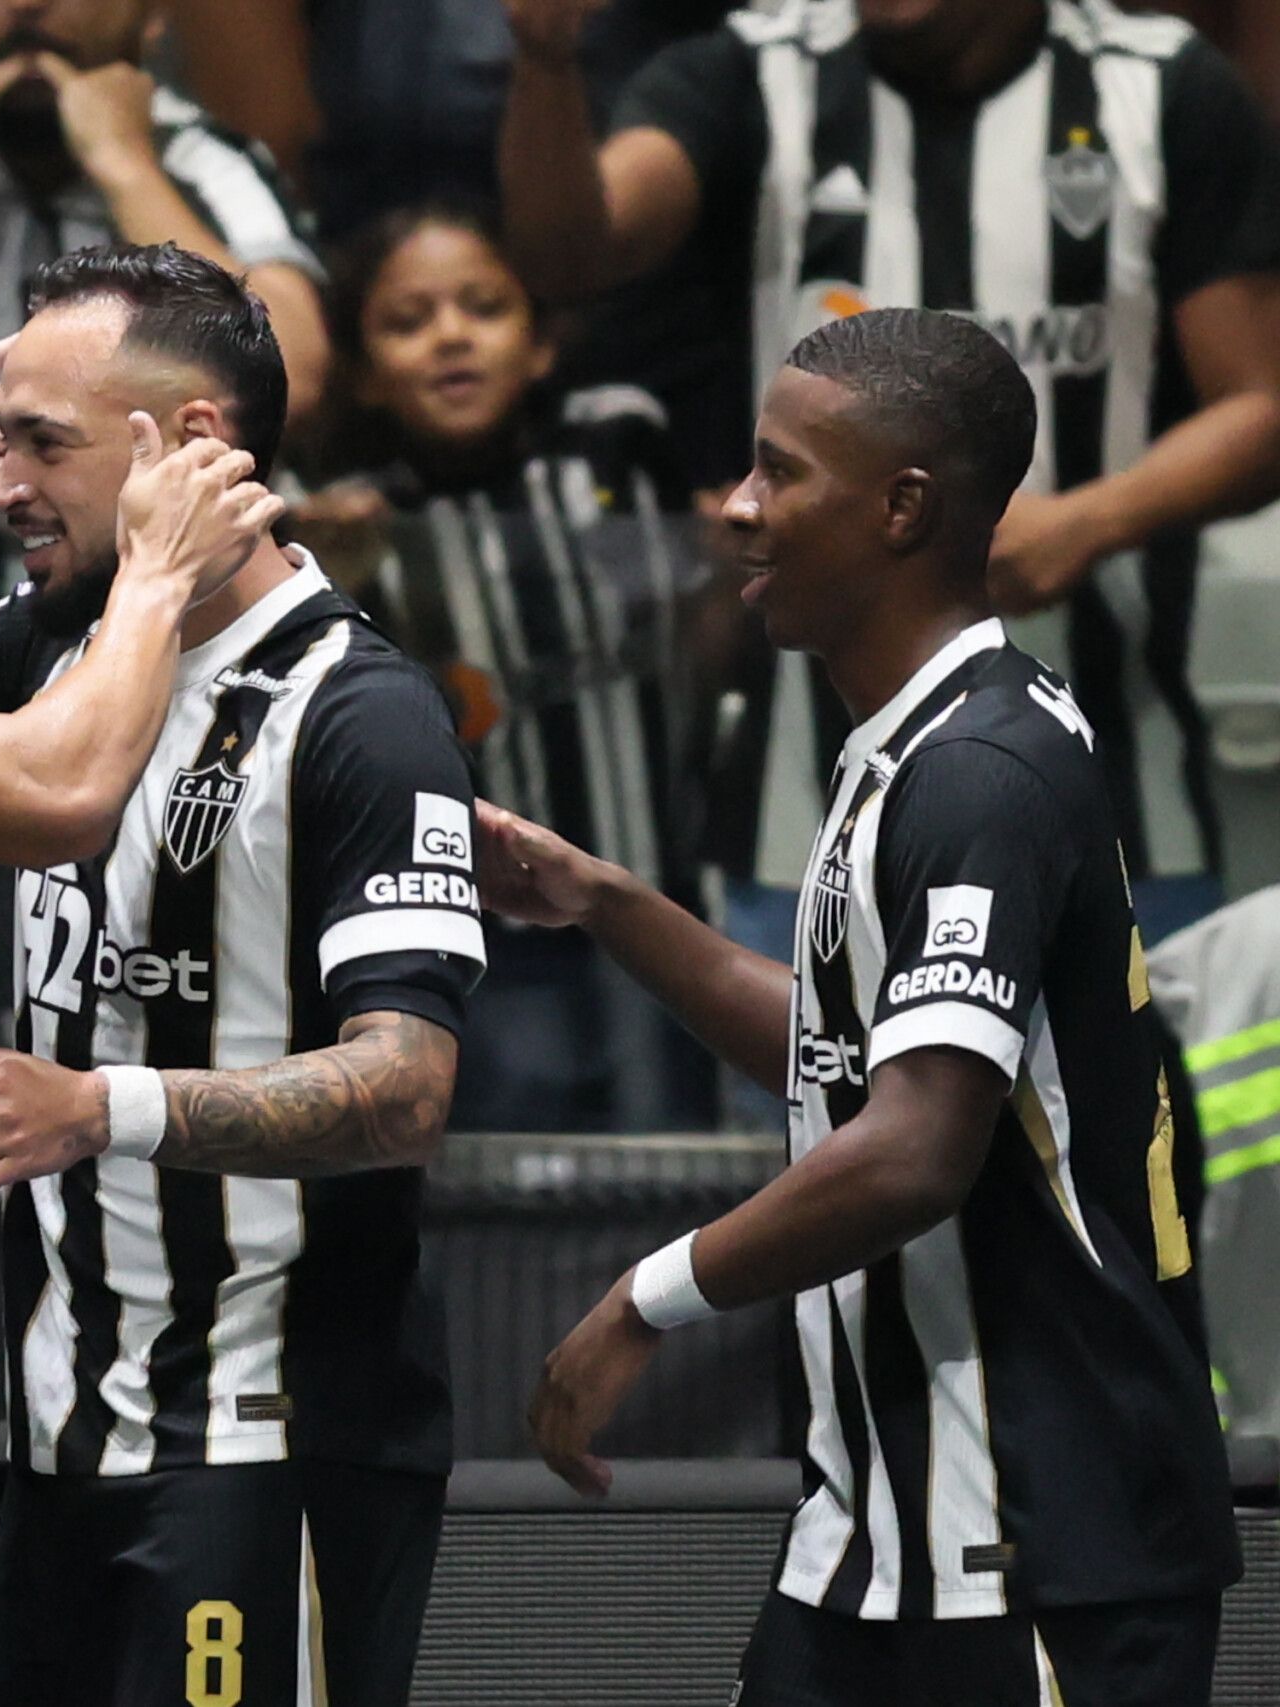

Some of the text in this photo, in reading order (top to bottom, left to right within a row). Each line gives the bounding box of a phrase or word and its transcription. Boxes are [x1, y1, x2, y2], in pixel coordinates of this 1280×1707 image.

[180, 778, 237, 801] CAM
[888, 961, 1016, 1010] GERDAU
[185, 1599, 243, 1707] 8
